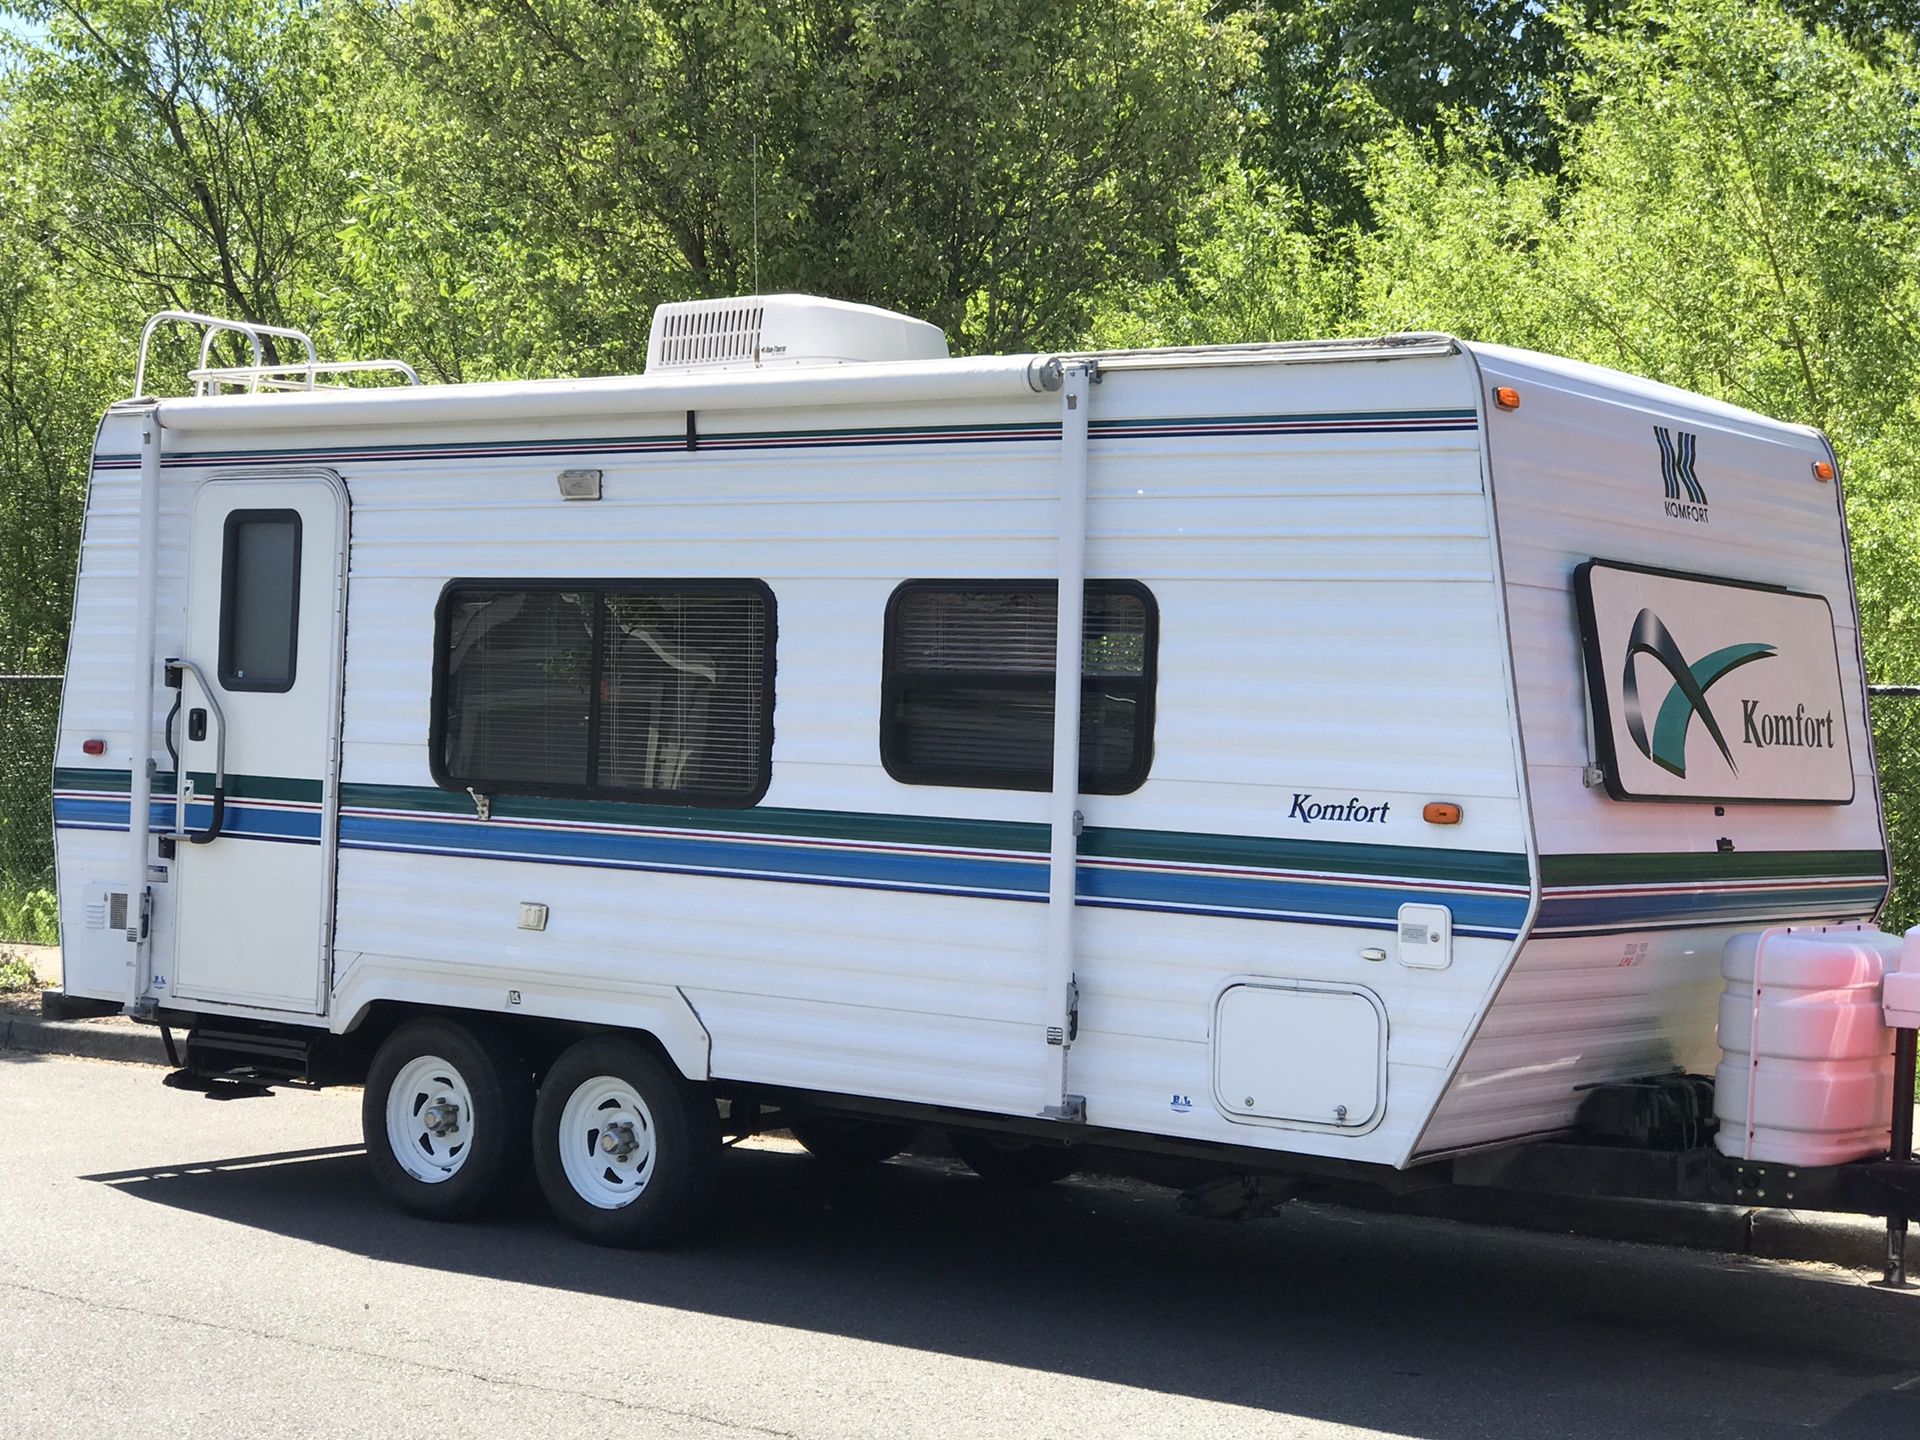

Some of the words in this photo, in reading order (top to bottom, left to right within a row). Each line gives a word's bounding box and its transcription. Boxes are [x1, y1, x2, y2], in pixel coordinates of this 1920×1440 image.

[1664, 501, 1709, 523] KOMFORT
[1741, 699, 1834, 749] Komfort
[1288, 793, 1390, 823] Komfort
